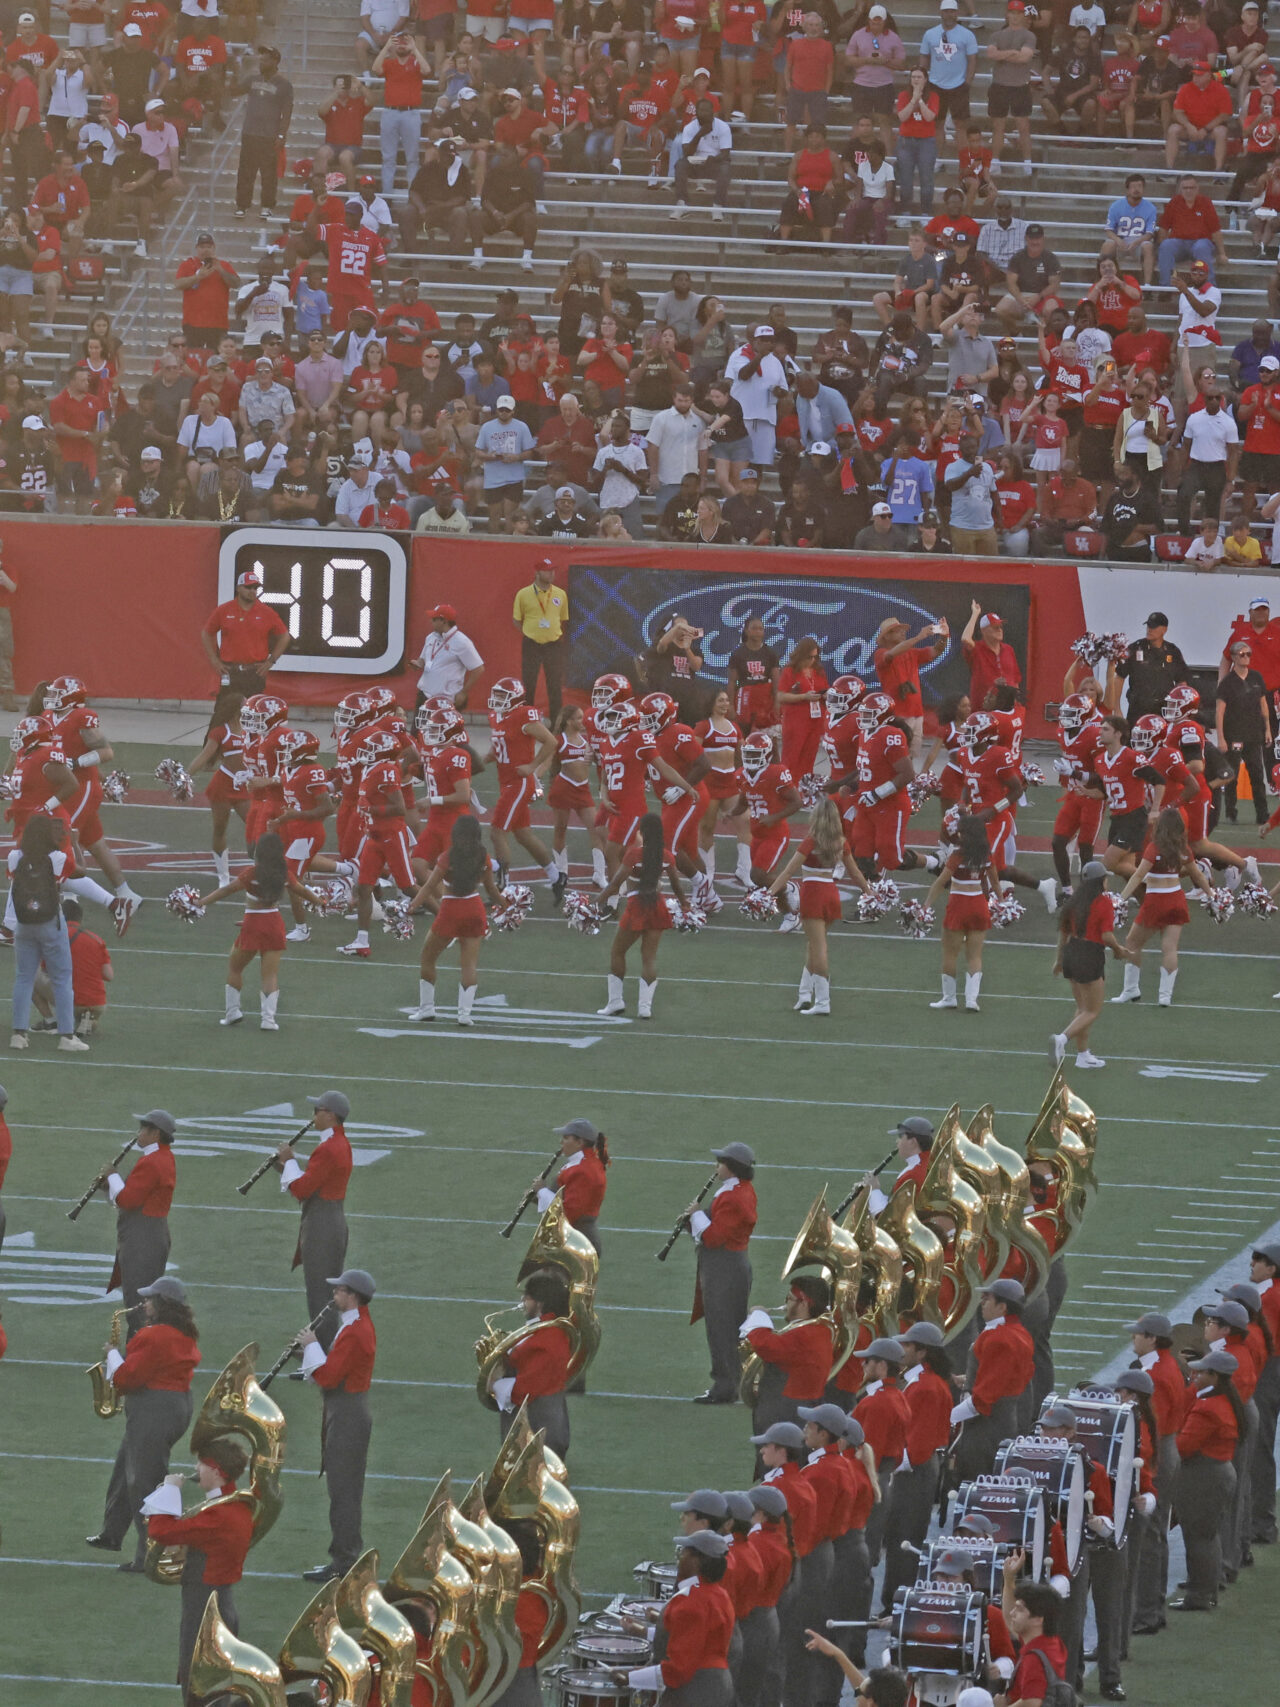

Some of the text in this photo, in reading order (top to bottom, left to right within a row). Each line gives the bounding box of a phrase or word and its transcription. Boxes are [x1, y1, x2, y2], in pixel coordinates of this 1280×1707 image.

[1119, 216, 1145, 237] 22
[342, 241, 370, 251] HOUSTON
[340, 250, 367, 276] 22
[890, 479, 917, 505] 27
[254, 557, 372, 649] 40
[85, 715, 99, 727] 74
[528, 709, 539, 721] 91
[642, 733, 656, 744] 92
[886, 735, 902, 746] 66
[50, 751, 65, 763] 98
[451, 755, 467, 769] 48
[1005, 752, 1013, 763] 2
[1169, 751, 1182, 764] 31
[310, 770, 325, 781] 33
[383, 770, 395, 782] 14
[780, 769, 792, 782] 46
[968, 778, 983, 803] 2
[980, 1495, 1017, 1505] TAMA
[918, 1596, 956, 1607] TAMA
